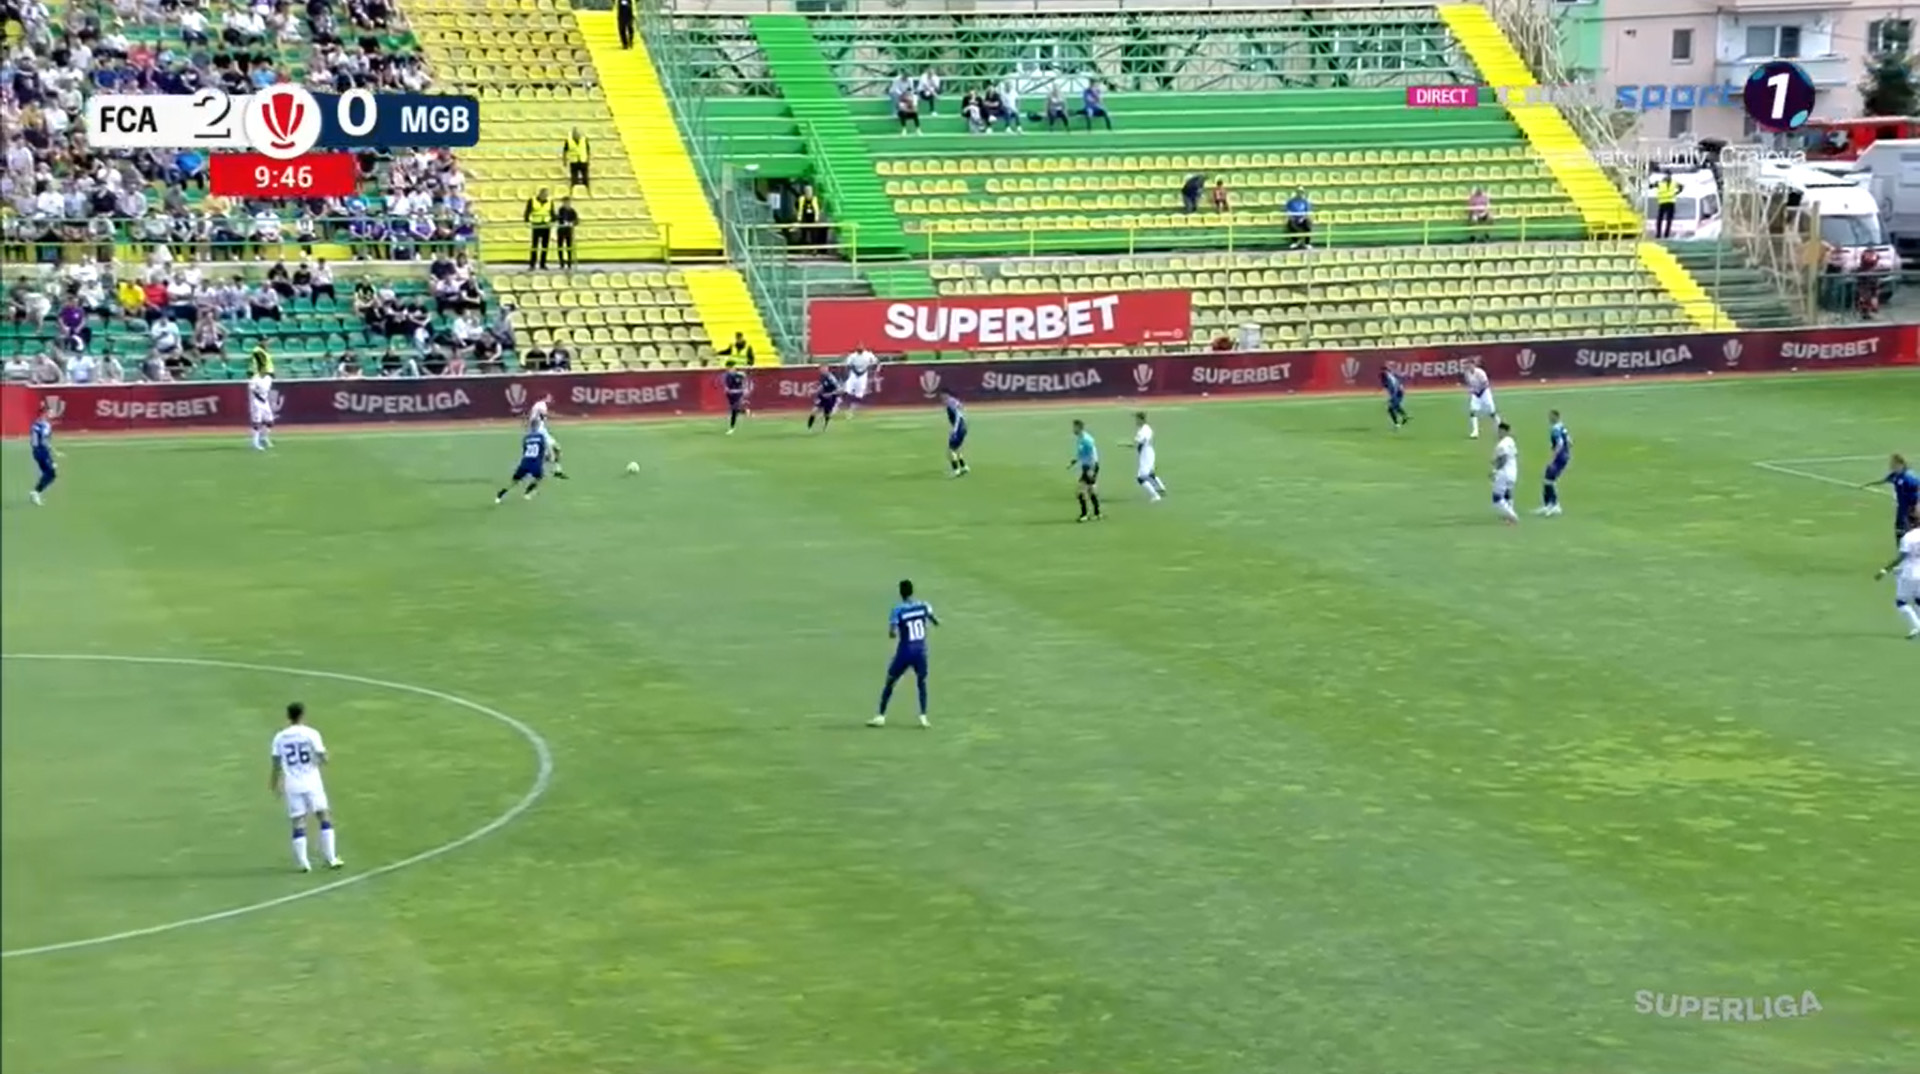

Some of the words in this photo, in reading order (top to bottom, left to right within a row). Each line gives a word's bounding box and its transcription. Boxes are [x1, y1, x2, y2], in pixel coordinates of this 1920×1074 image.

[884, 295, 1120, 342] SUPERBET
[1575, 343, 1692, 369] SUPERLIGA
[1779, 337, 1880, 359] SUPERBET
[981, 367, 1102, 393] SUPERLIGA
[1192, 362, 1292, 385] SUPERBET
[333, 388, 470, 414] SUPERLIGA
[571, 382, 680, 405] SUPERBET
[96, 396, 220, 419] SUPERBET
[906, 619, 926, 642] 10
[283, 742, 311, 767] 26
